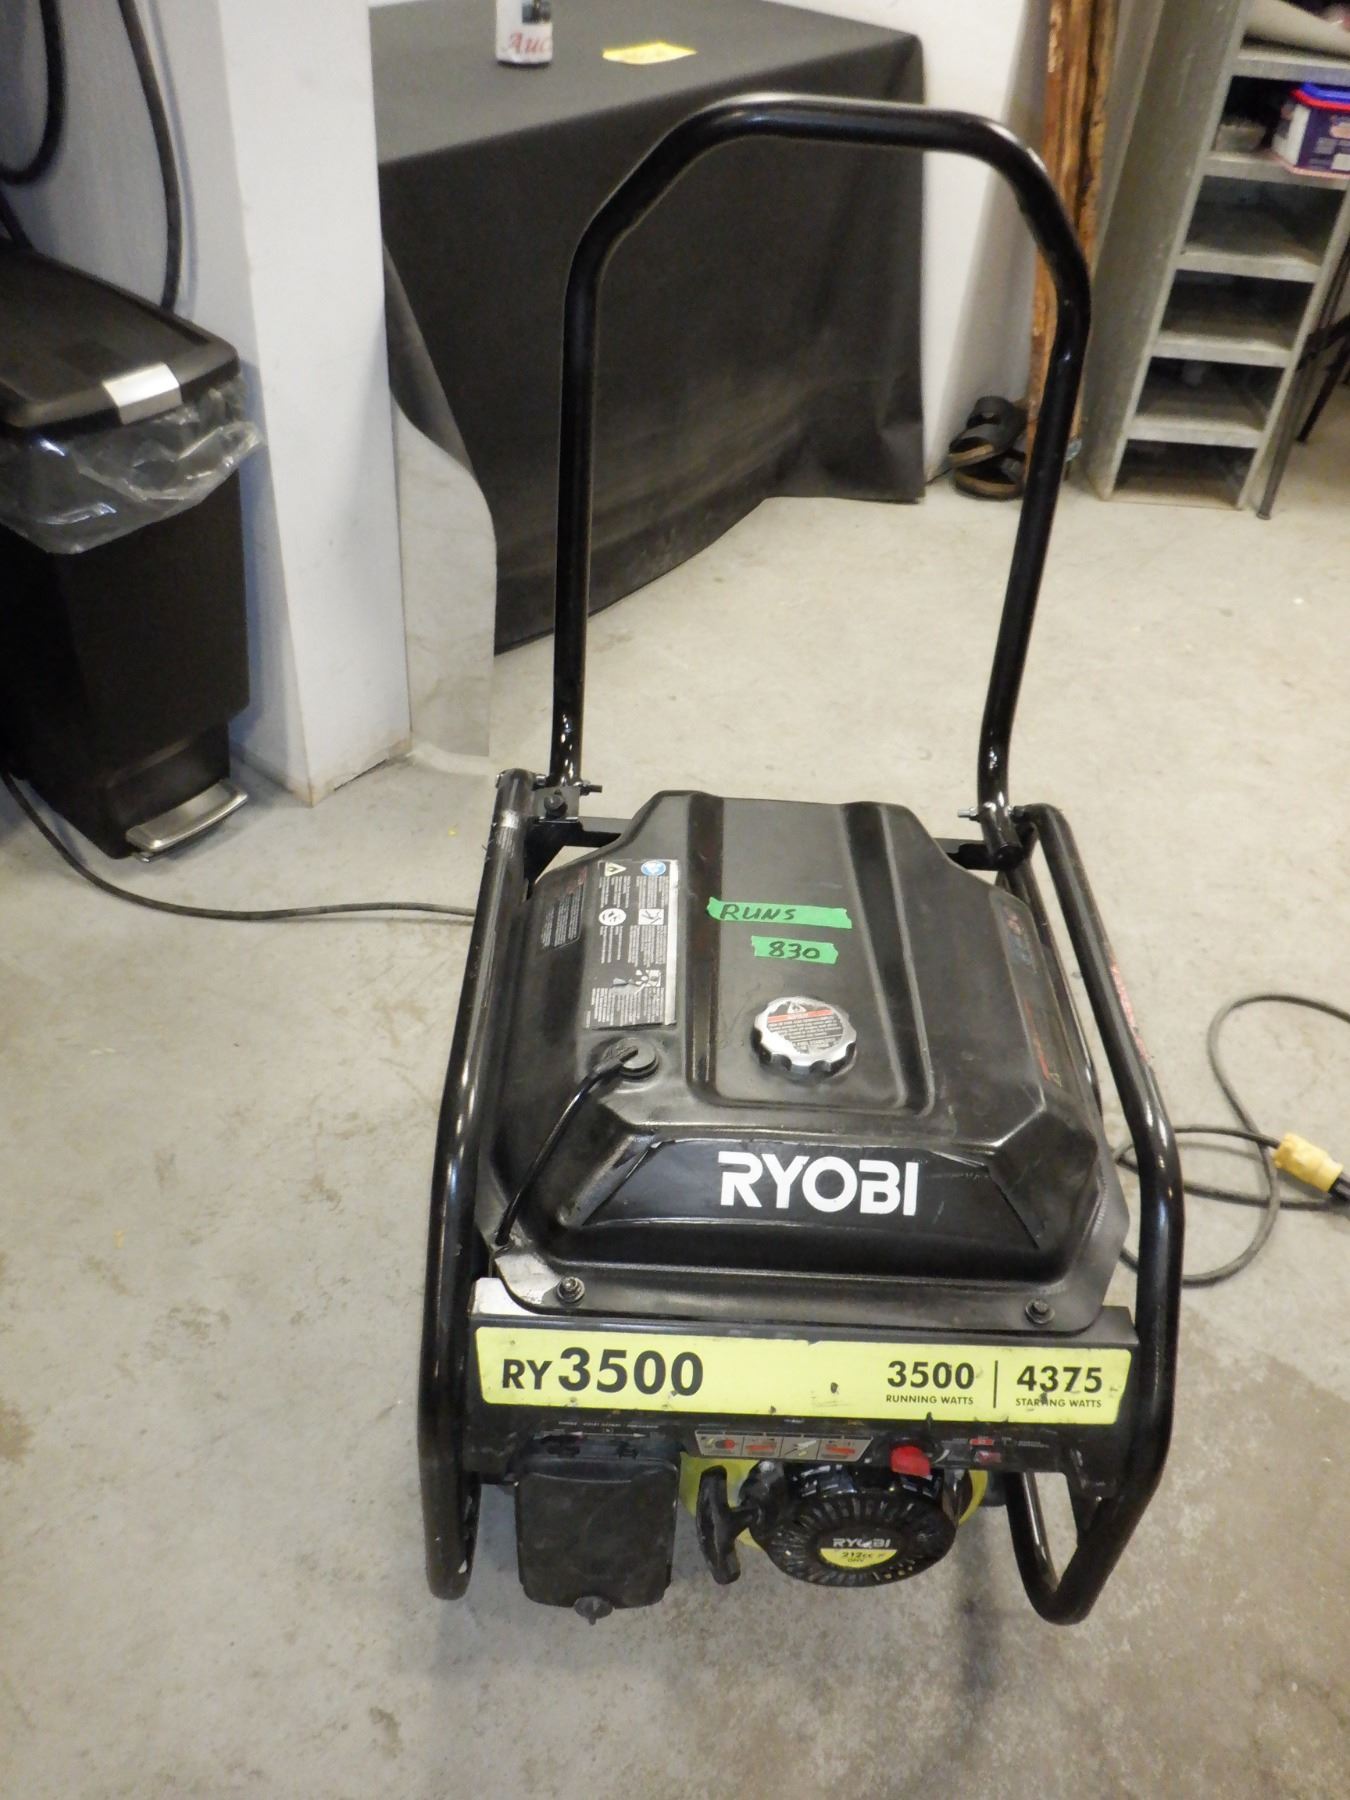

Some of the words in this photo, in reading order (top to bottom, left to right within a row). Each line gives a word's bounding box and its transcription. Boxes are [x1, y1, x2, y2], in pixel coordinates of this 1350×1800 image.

[719, 903, 797, 921] RUNS
[768, 941, 821, 960] 830
[717, 1150, 920, 1217] RYOBI
[887, 1360, 975, 1390] 3500
[1016, 1365, 1103, 1394] 4375
[886, 1394, 937, 1405] RUNNING
[940, 1396, 974, 1406] WATTS
[1069, 1399, 1103, 1409] WATTS
